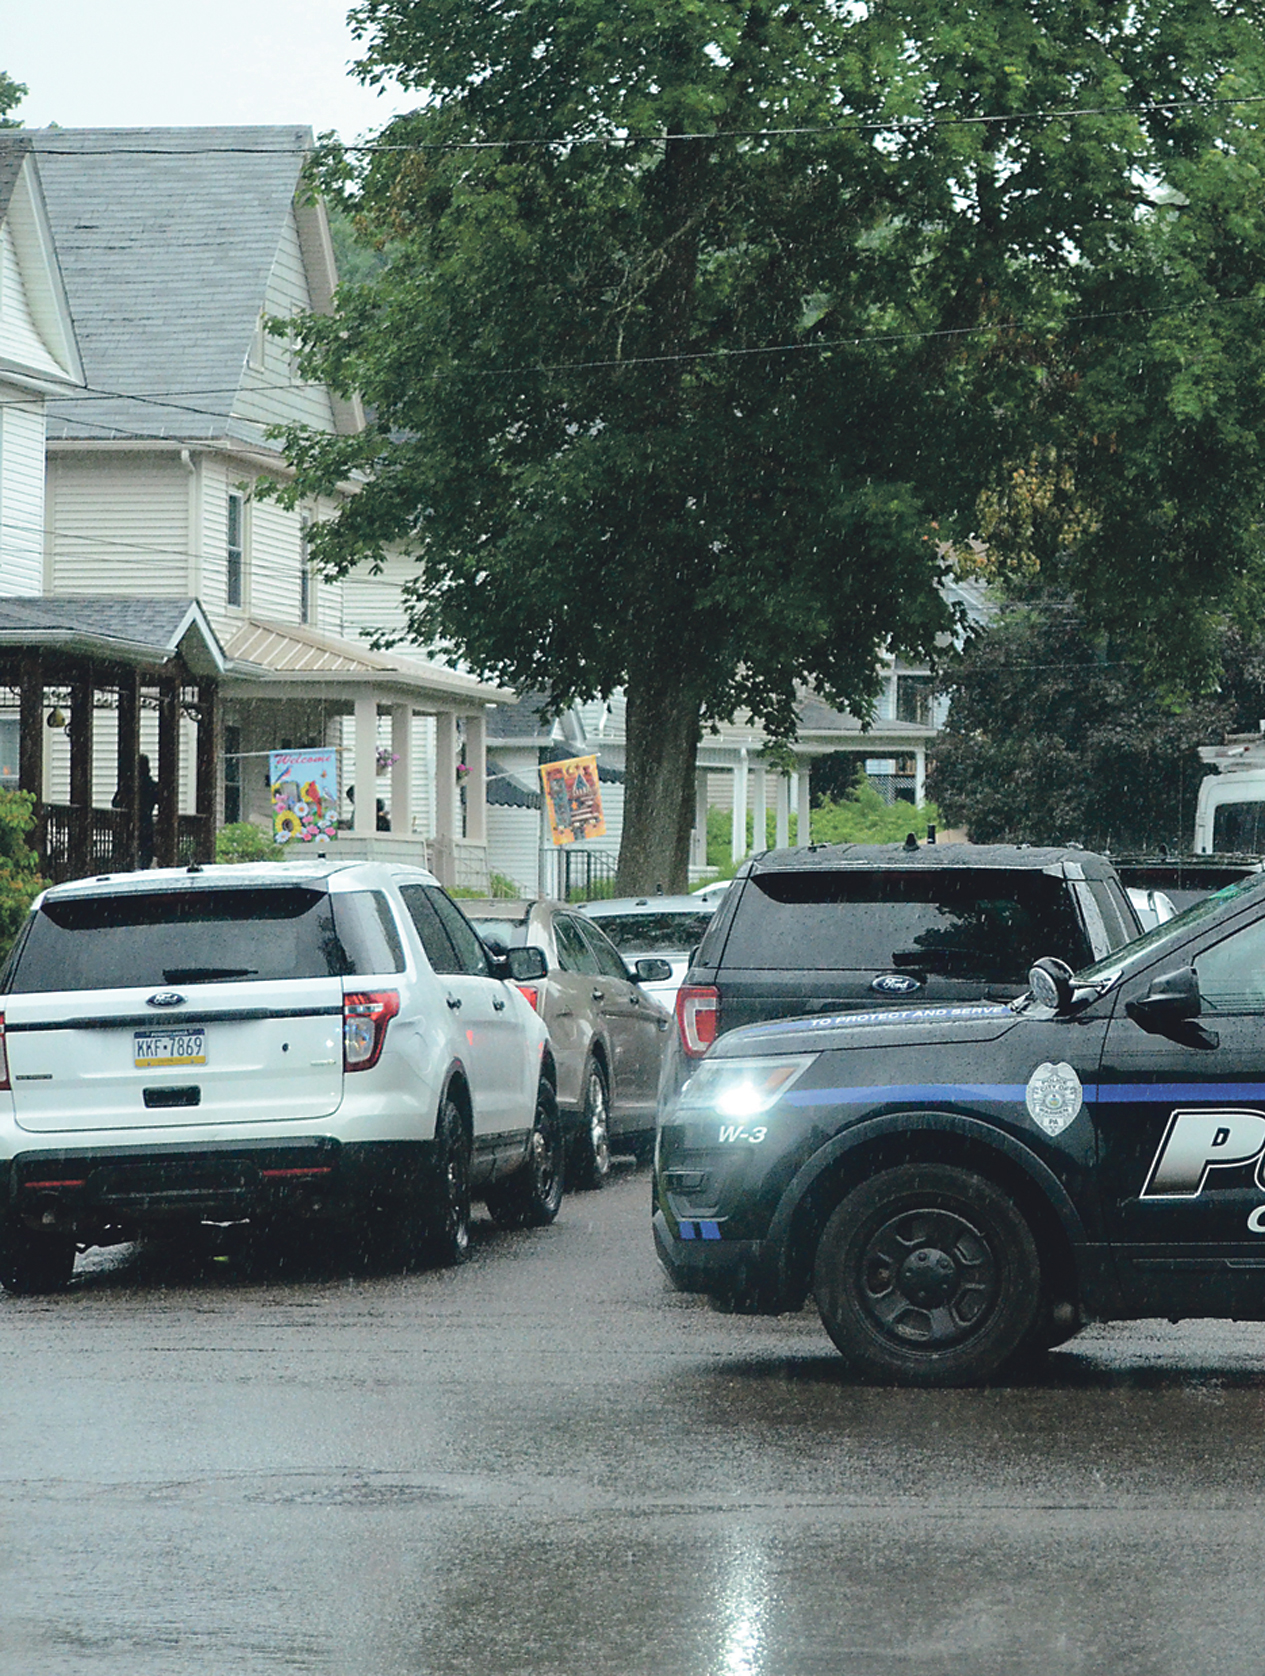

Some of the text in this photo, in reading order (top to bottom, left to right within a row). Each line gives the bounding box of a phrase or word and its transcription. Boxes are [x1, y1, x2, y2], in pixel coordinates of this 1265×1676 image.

[274, 754, 331, 765] Welcome
[811, 1006, 1002, 1026] TO PROTECT AND SERVE
[718, 1125, 768, 1144] W-3
